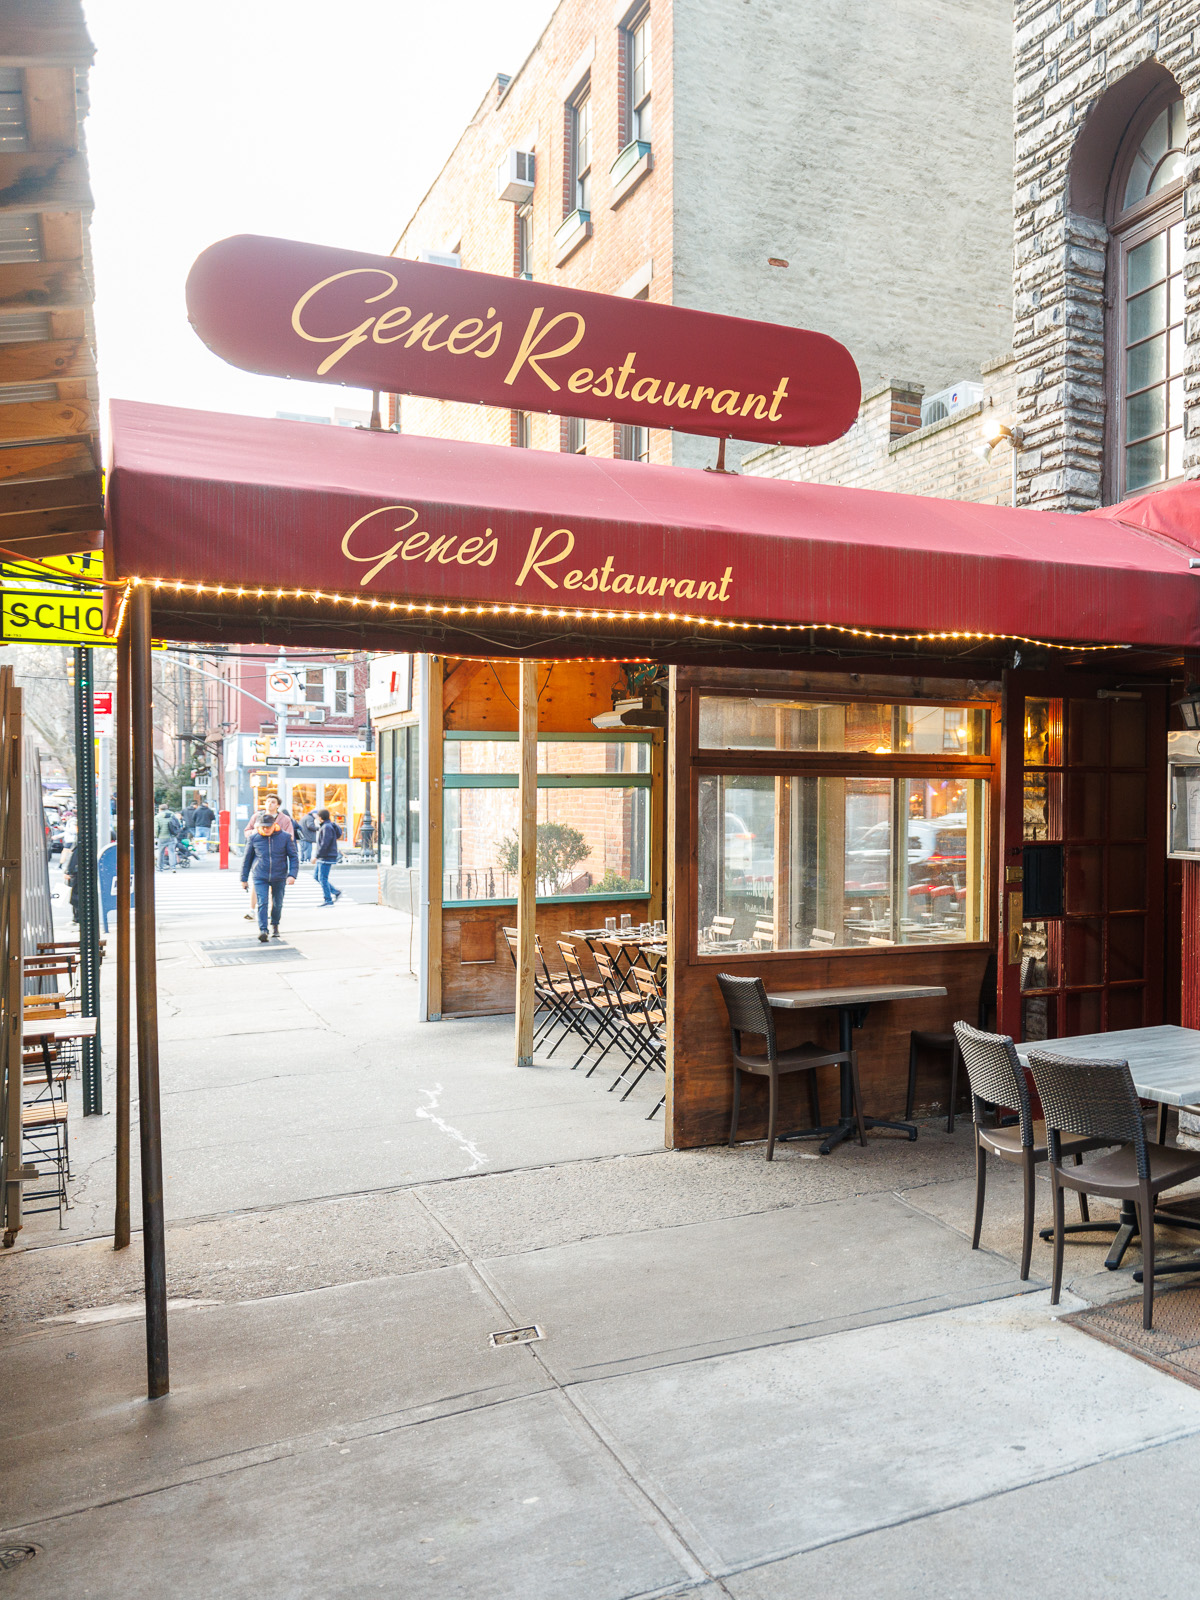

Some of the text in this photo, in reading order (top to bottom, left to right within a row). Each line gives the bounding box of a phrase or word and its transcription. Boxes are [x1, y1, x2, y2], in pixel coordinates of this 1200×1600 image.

[291, 268, 789, 422] Gene's Restaurant
[341, 505, 733, 602] Gene's Restaurant
[9, 602, 103, 631] SCHO
[290, 740, 324, 748] PIZZA
[320, 754, 350, 763] SOO
